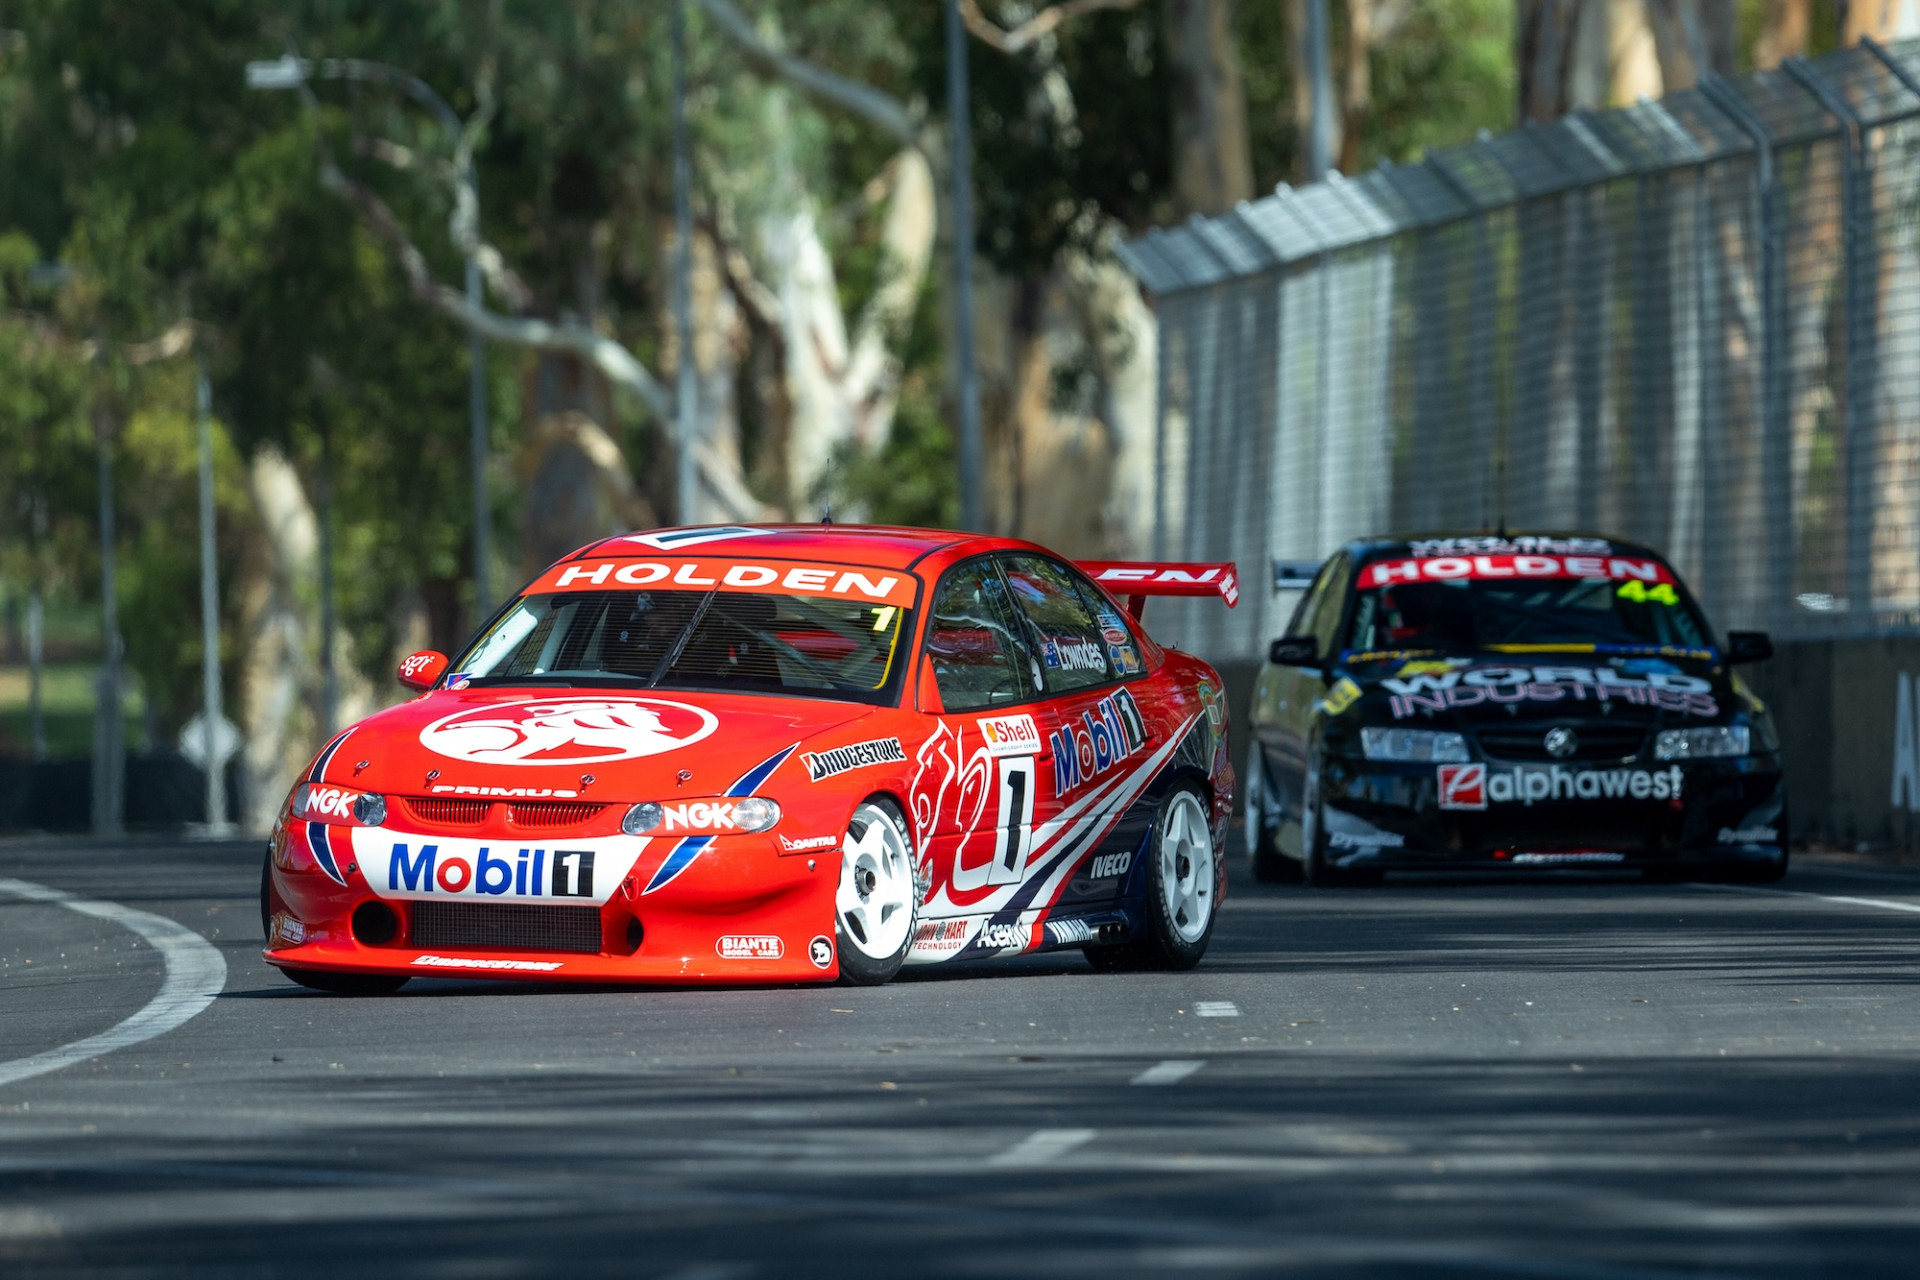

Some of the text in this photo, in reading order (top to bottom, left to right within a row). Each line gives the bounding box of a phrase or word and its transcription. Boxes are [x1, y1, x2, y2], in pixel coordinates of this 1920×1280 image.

[554, 562, 899, 599] HOLDEN
[1371, 555, 1658, 585] HOLDEN
[1616, 580, 1680, 606] 44
[870, 605, 897, 632] 1
[1053, 636, 1105, 671] Lowndes
[1381, 667, 1713, 697] WORLD
[1389, 681, 1720, 719] INDUSTRIES
[994, 718, 1035, 742] Shell
[1050, 691, 1145, 799] Mobil 1
[809, 737, 905, 781] BRIDGESTONE
[431, 785, 579, 798] PRIMUS
[1487, 765, 1684, 805] alphawest
[303, 788, 358, 818] NGK
[663, 802, 736, 831] NGK
[1003, 769, 1026, 872] 1
[793, 835, 838, 850] QANTAS
[388, 843, 583, 897] Mobil 1
[1090, 851, 1132, 879] IVECO
[722, 938, 778, 949] BIANTE
[944, 920, 968, 940] HART
[913, 941, 962, 951] TECHNOLOGY
